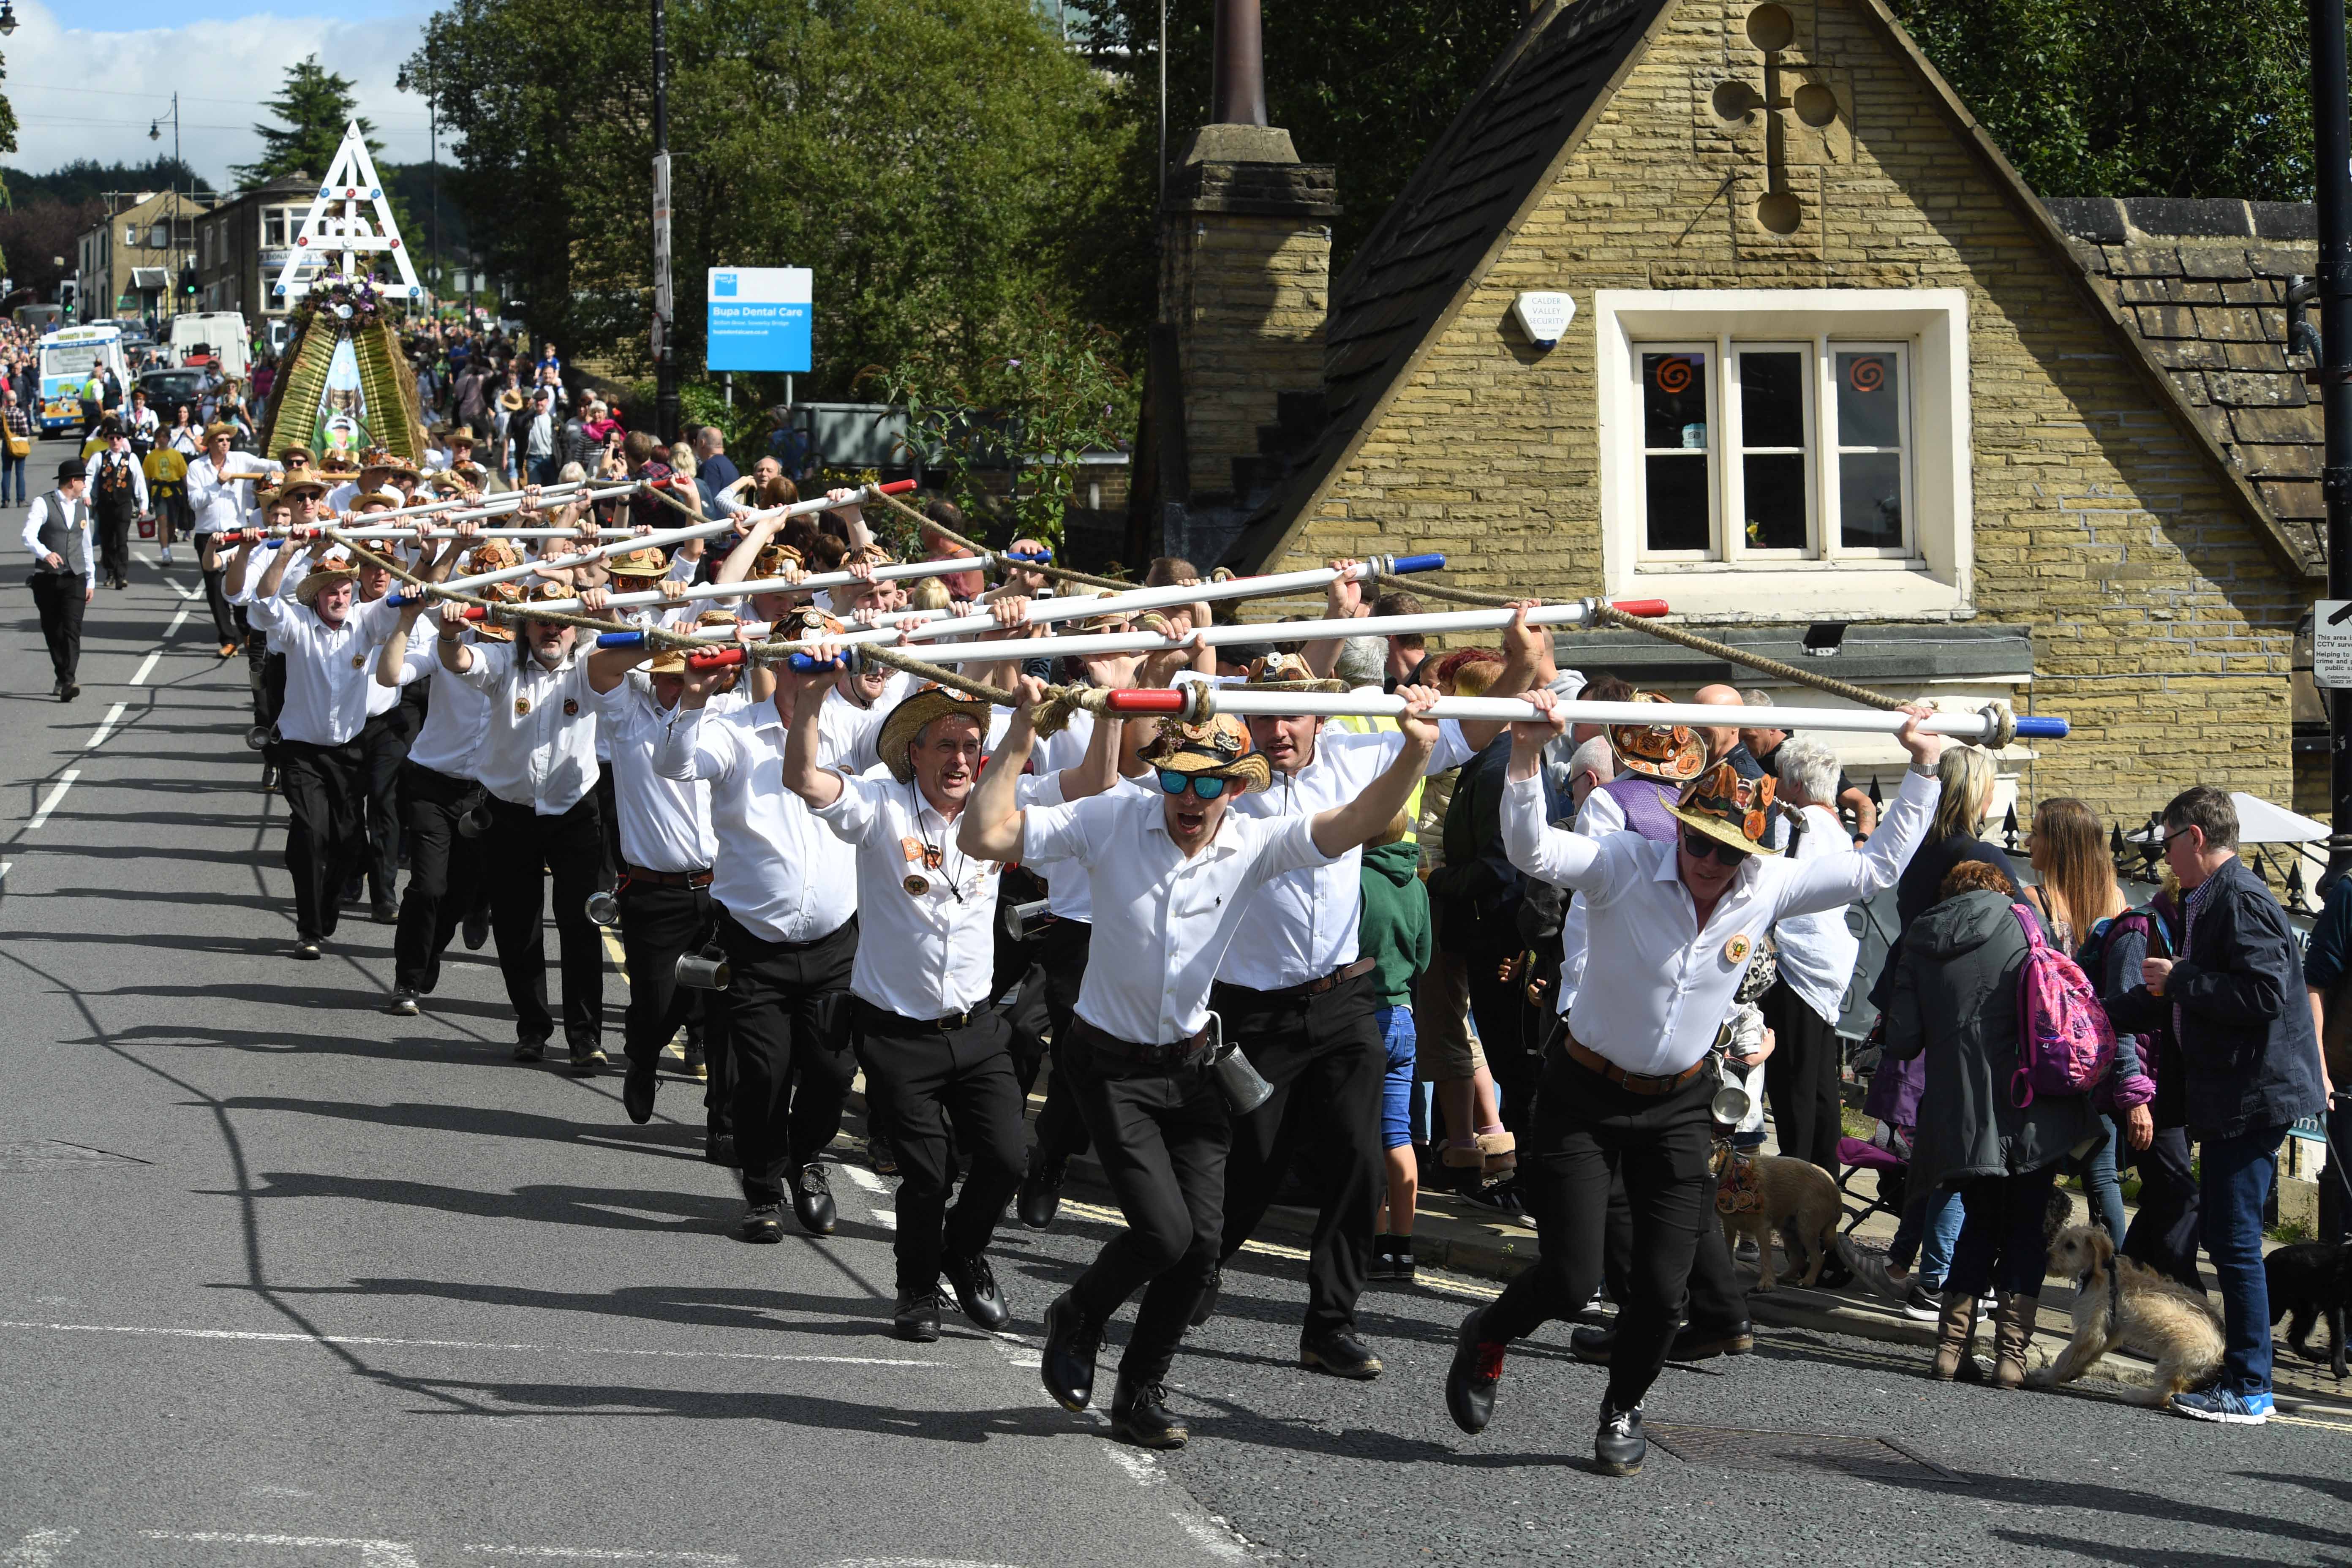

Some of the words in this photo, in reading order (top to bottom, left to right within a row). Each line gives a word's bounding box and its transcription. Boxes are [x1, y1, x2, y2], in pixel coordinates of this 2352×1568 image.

[713, 307, 739, 317] Bupa
[743, 308, 776, 316] Dental
[779, 308, 803, 316] Care
[653, 326, 661, 346] 20
